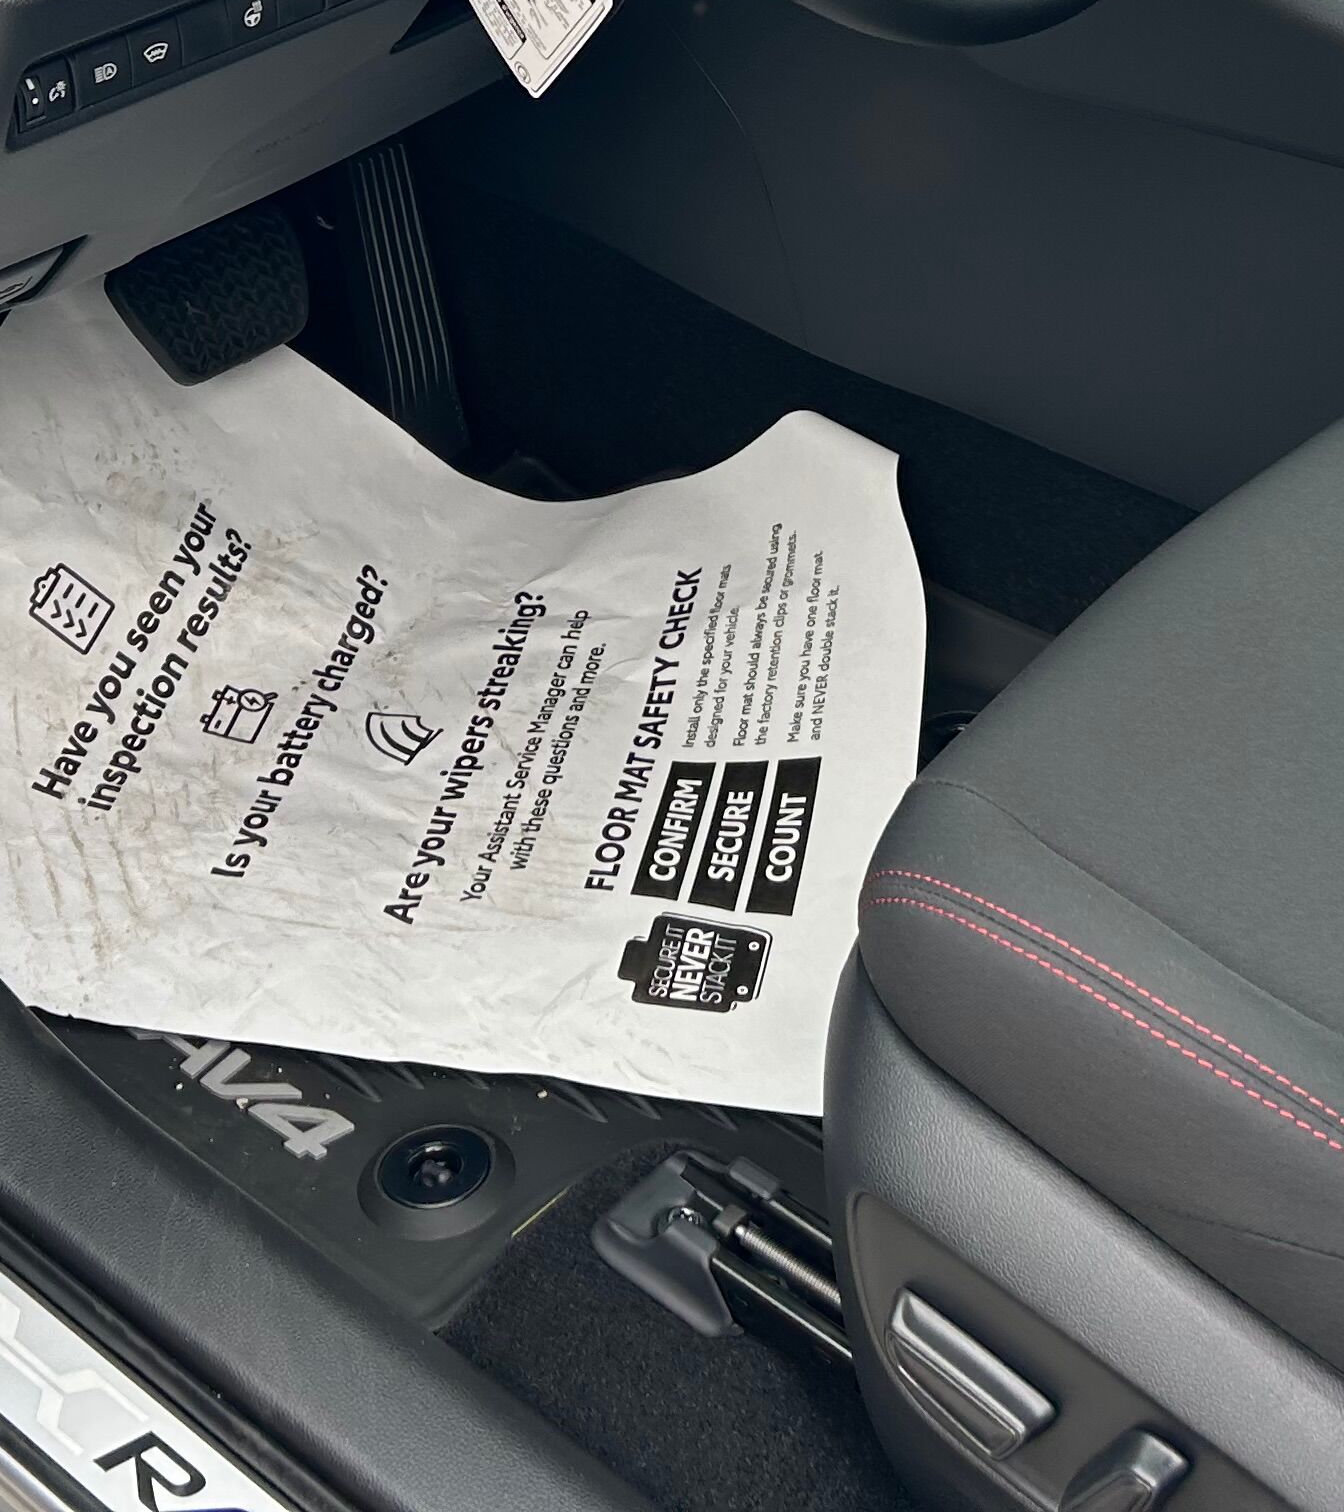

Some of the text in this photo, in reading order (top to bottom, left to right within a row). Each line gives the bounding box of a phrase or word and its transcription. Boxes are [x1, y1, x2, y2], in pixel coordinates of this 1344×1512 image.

[32, 502, 218, 800] Have you seen your
[732, 522, 783, 746] Floor mat should always be secured using
[754, 529, 797, 746] the factory retention clips or grommets.
[800, 629, 813, 656] have
[806, 578, 822, 603] floor
[807, 604, 818, 628] one
[76, 528, 253, 812] inspection results?
[682, 563, 732, 748] Install only the specified floor mats
[704, 606, 740, 748] designed for your vehicle.
[794, 683, 808, 709] sure
[798, 656, 810, 683] you
[810, 585, 840, 740] and NEVER double stack it.
[210, 564, 390, 879] Is your battery charged?
[383, 591, 546, 925] Are your wipers streaking?
[460, 609, 589, 903] Your Assistant Service Manager can help
[510, 642, 606, 871] with these questions and more.
[584, 567, 703, 890] FLOOR MAT SAFETY CHECK
[786, 711, 803, 743] Make
[648, 777, 703, 882] CONFIRM
[707, 790, 755, 882] SECURE
[764, 792, 807, 883] COUNT
[649, 923, 686, 998] SECURE IT
[669, 928, 714, 1002] NEVER
[700, 933, 737, 1004] STACK IT
